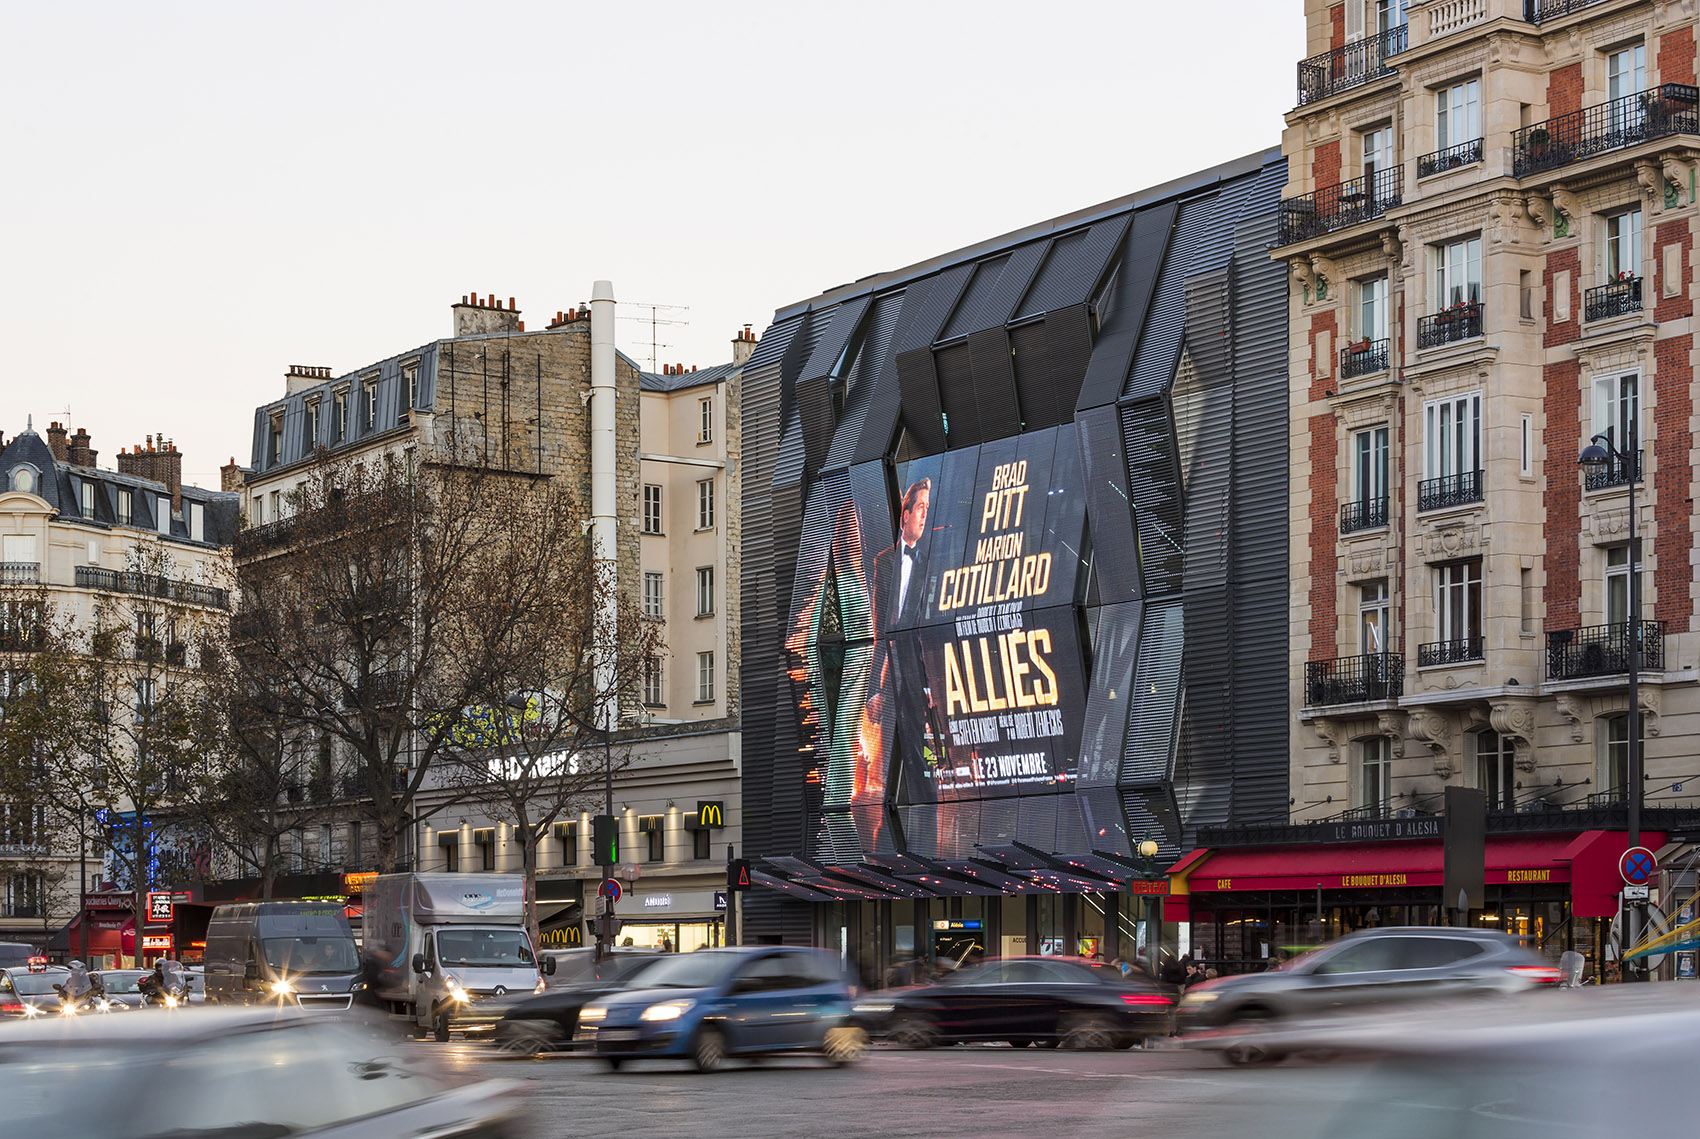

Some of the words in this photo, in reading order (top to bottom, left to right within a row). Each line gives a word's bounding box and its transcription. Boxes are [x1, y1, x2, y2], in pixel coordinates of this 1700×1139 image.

[992, 460, 1027, 491] BRAD
[980, 484, 1029, 534] PITT
[975, 531, 1024, 565] MARION
[938, 552, 1052, 611] COTILLARD
[944, 628, 1059, 716] ALLIÉS
[972, 758, 986, 779] LE
[985, 756, 998, 778] 23
[998, 752, 1048, 777] NOVEMBRE
[1335, 826, 1346, 839] LE
[1352, 824, 1390, 838] BOUQUET
[1217, 879, 1232, 889] CAFE
[1342, 876, 1350, 886] LE
[1351, 875, 1378, 886] BOUQUET
[1380, 874, 1407, 885] D'ALESIA
[1508, 870, 1551, 881] RESTAURANT
